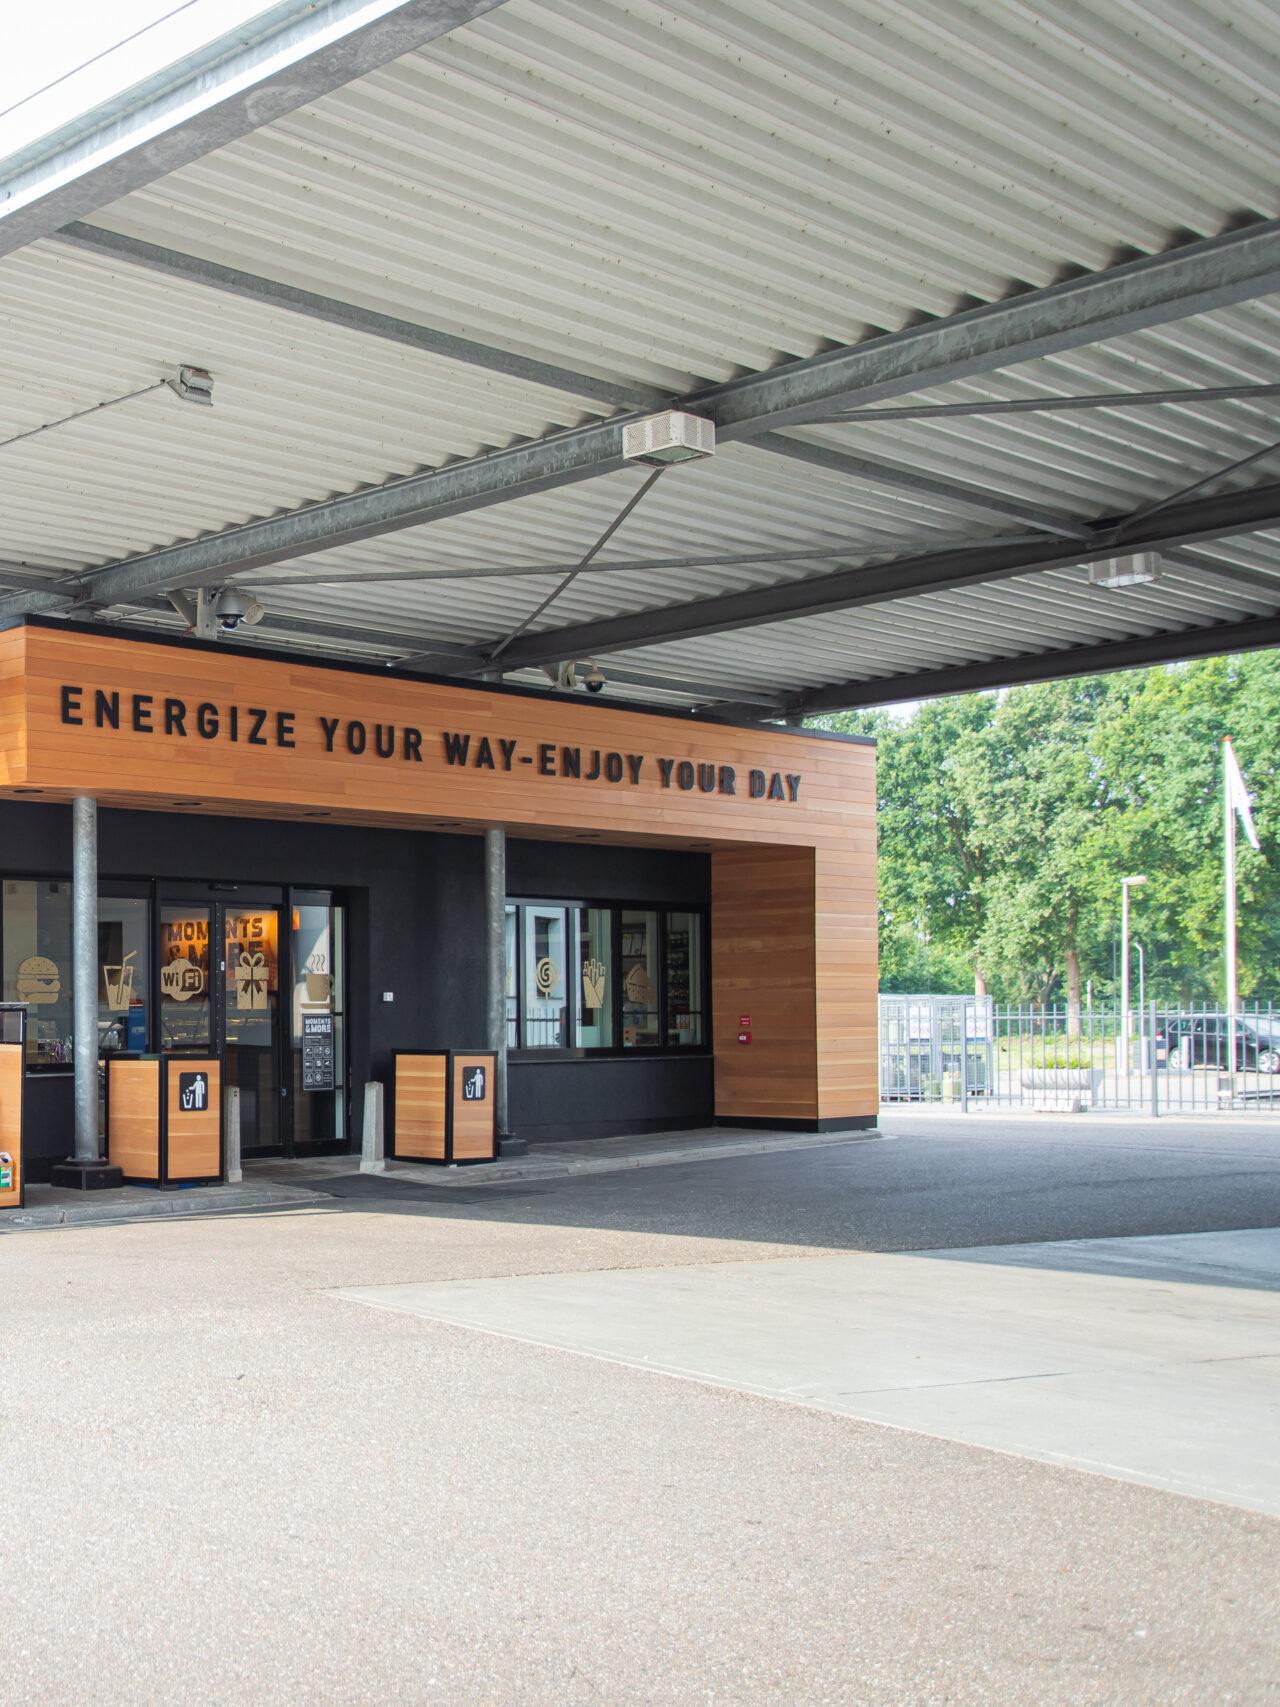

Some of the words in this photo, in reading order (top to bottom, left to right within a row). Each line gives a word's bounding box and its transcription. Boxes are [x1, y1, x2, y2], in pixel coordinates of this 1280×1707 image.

[61, 685, 296, 748] ENERGIZE
[320, 716, 423, 761] YOUR
[659, 758, 736, 795] YOUR
[751, 769, 801, 801] DAY
[168, 918, 263, 942] MOMNTS
